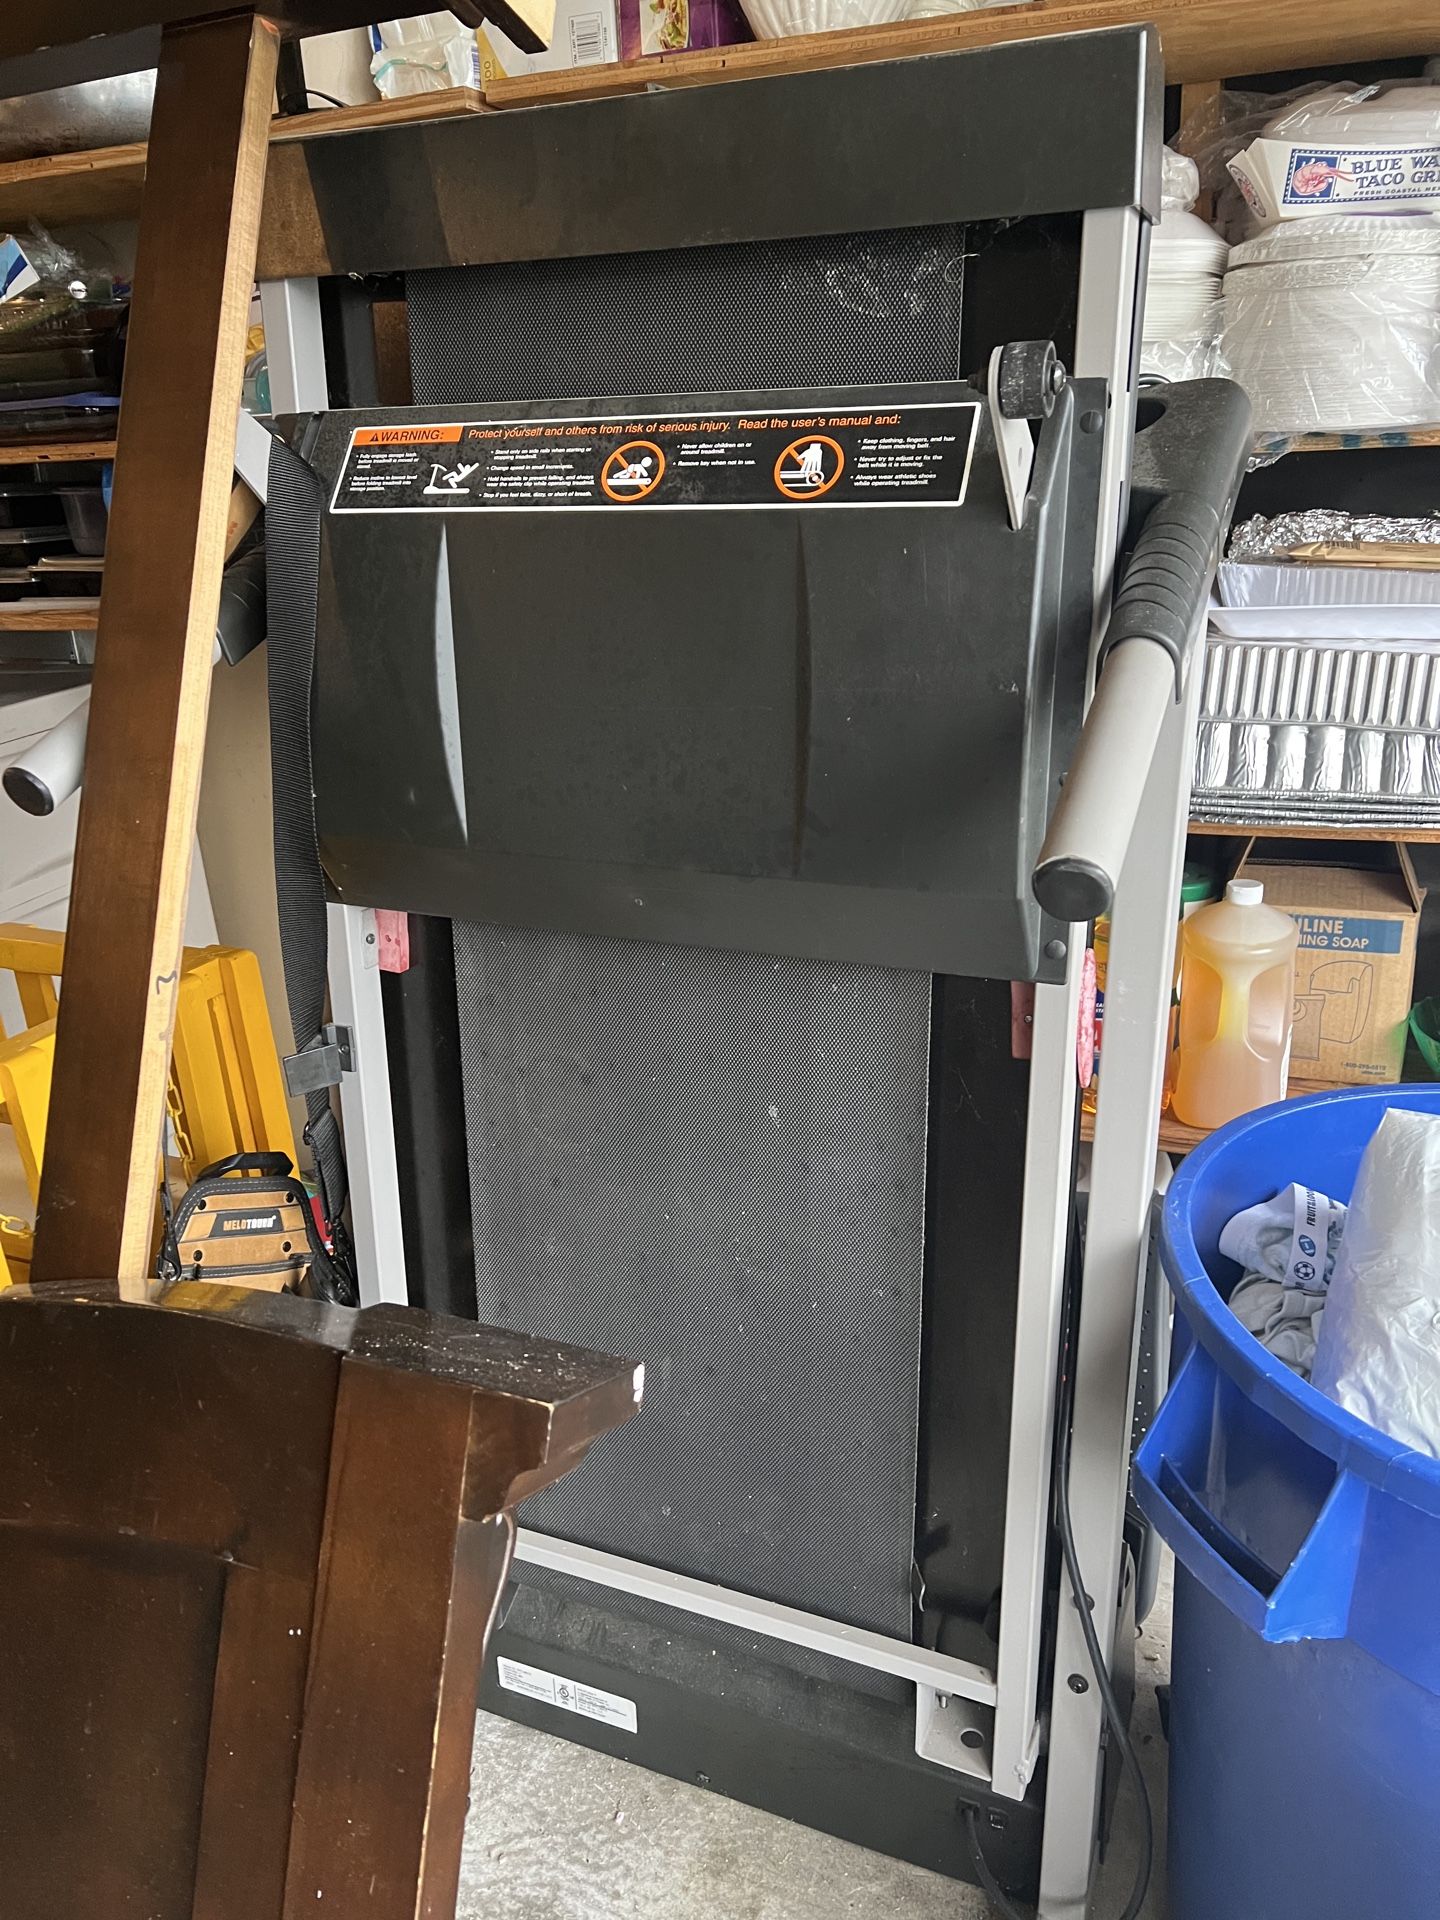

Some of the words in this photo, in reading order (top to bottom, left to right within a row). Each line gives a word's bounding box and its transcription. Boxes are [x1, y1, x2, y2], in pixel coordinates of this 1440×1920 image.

[1351, 158, 1402, 174] BLUE
[1355, 172, 1405, 189] TACO
[469, 428, 502, 438] Protect
[503, 427, 543, 440] yourself
[545, 426, 564, 436] and
[565, 424, 597, 435] others
[599, 423, 623, 434] from
[625, 422, 644, 433] risk
[645, 422, 657, 432] of
[658, 421, 698, 432] serious
[700, 420, 731, 432] injury.
[738, 418, 768, 429] Read
[770, 418, 788, 428] the
[791, 416, 826, 428] user's
[828, 415, 872, 427] manual
[874, 414, 902, 426] and:
[381, 430, 444, 441] WARNING:
[1332, 936, 1369, 949] SOAP
[1306, 1205, 1316, 1227] FRUIT
